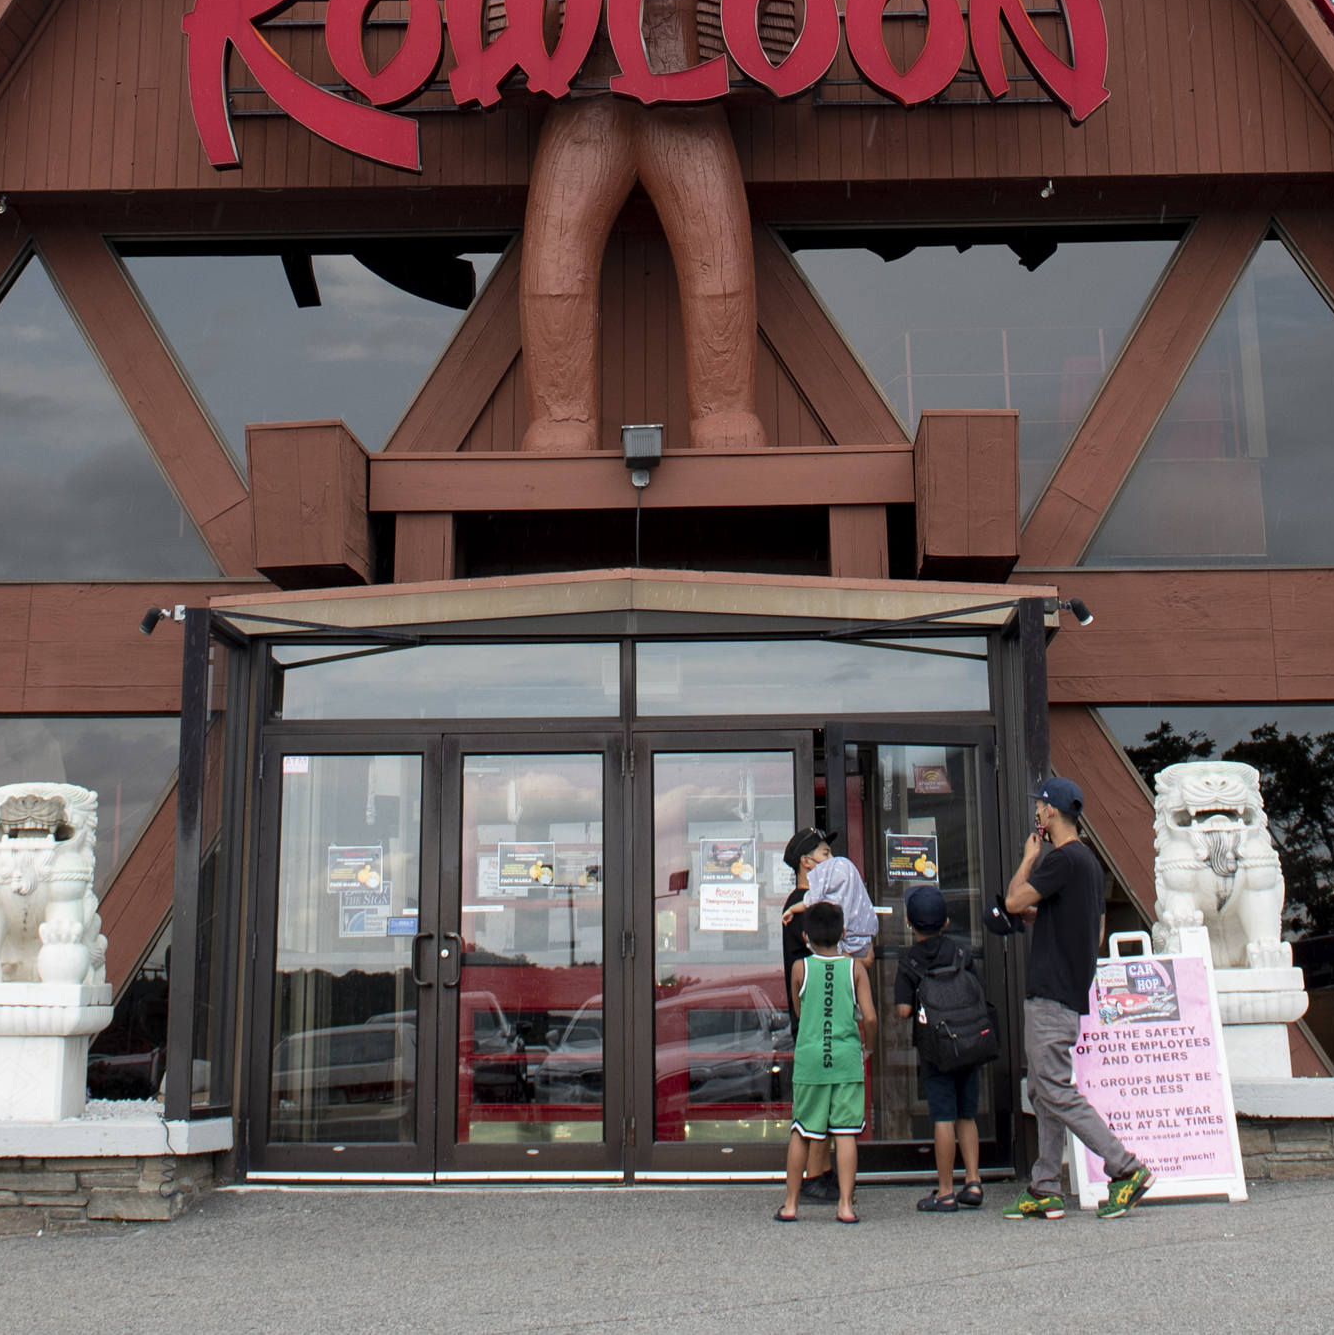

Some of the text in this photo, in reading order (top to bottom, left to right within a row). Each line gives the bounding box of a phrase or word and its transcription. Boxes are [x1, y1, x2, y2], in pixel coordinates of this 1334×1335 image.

[285, 757, 307, 765] ATM
[1128, 963, 1154, 976] CAR
[1136, 978, 1159, 991] HOP
[823, 963, 834, 1069] BOSTON CELTICS
[1083, 1026, 1196, 1042] FOR THE SAFETY
[1076, 1037, 1211, 1055] OF OUR EMPLOYEES
[1102, 1051, 1188, 1066] AND OTHERS
[1085, 1072, 1212, 1089] 1. GROUPS MUST BE
[1119, 1084, 1184, 1097] 6 OR LESS
[1105, 1105, 1212, 1121] YOU MUST WEAR
[1108, 1115, 1224, 1132] ASK AT ALL TIMES
[1153, 1132, 1181, 1140] seated
[1202, 1128, 1224, 1136] table
[1137, 1152, 1216, 1165] you very much!!
[1148, 1163, 1182, 1172] owloon
